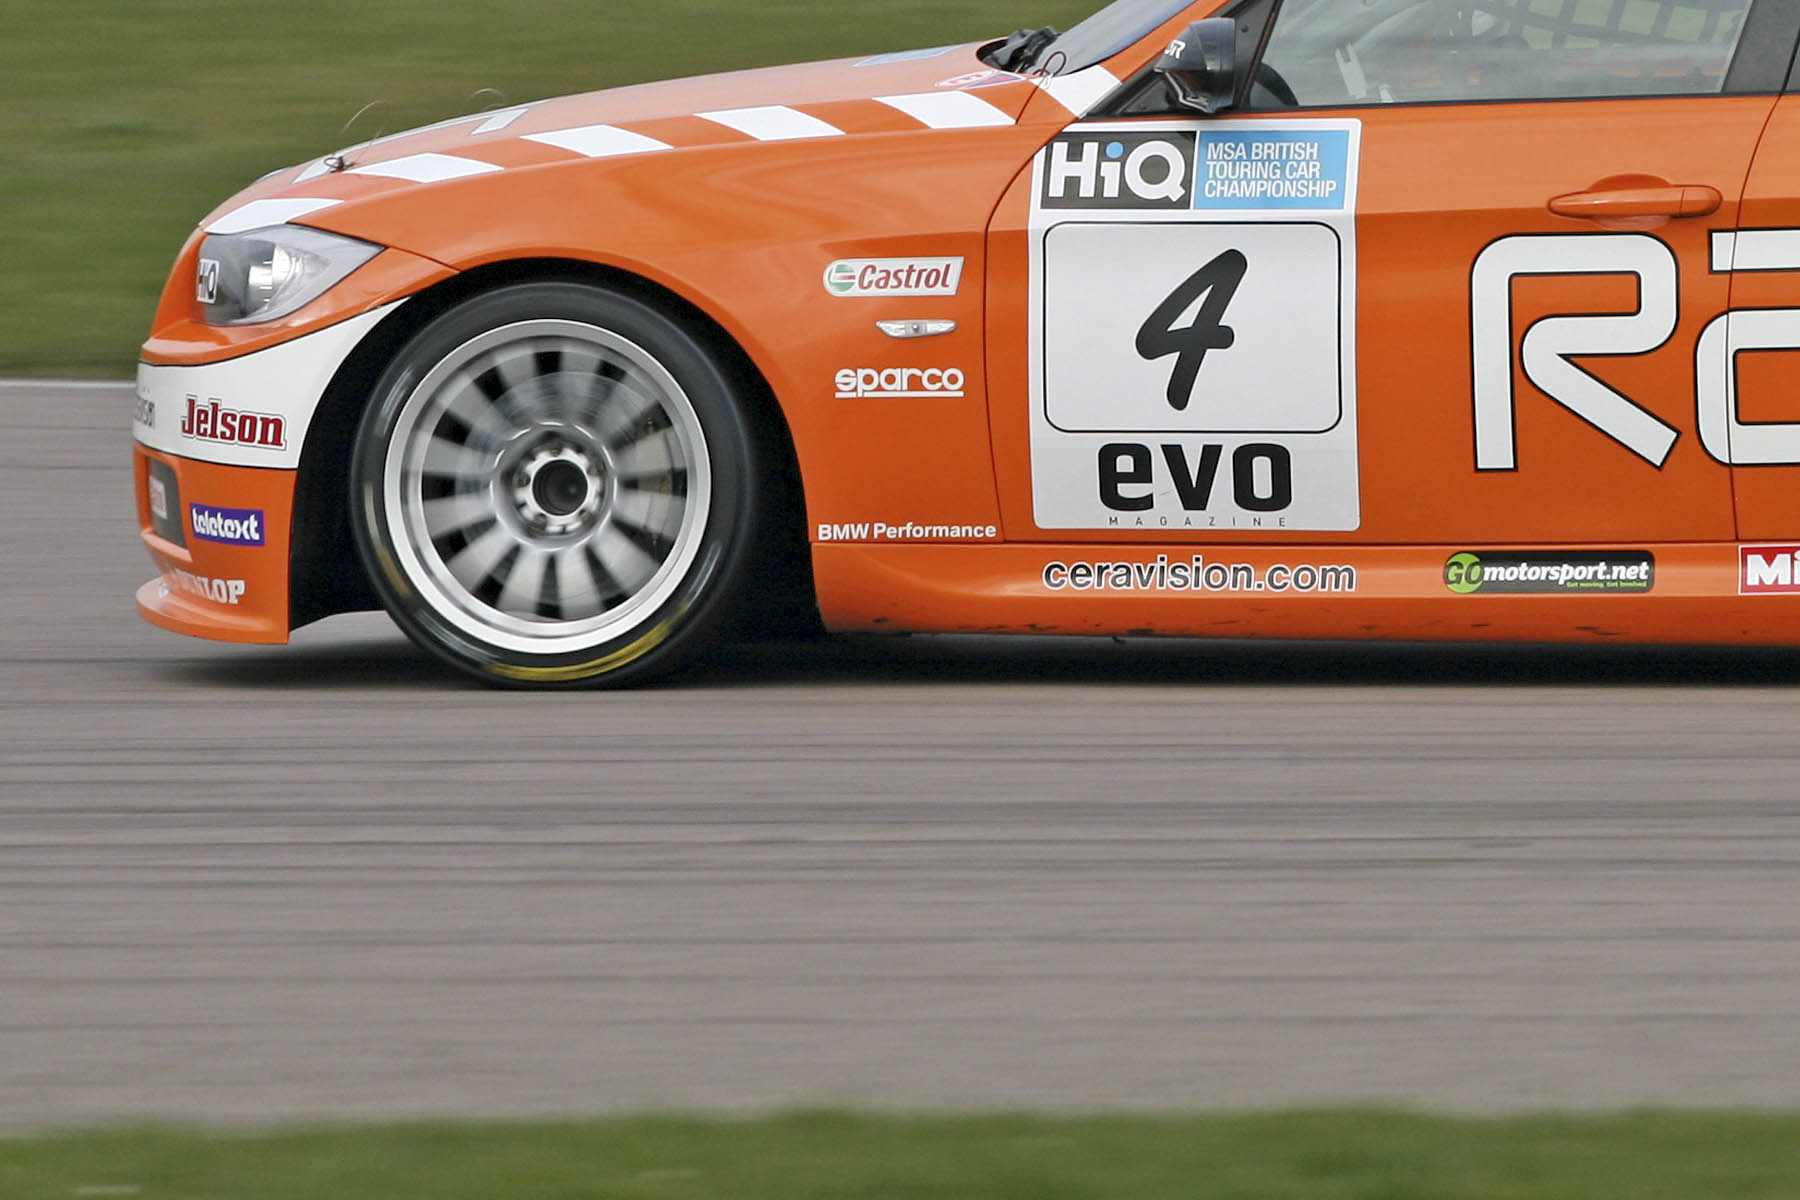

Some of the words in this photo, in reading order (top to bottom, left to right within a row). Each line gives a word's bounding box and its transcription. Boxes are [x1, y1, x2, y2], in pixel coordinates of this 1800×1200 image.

[1207, 142, 1246, 160] MSA
[1251, 142, 1318, 160] BRITISH
[1048, 139, 1186, 202] HiQ
[1206, 161, 1281, 179] TOURING
[1285, 161, 1320, 179] CAR
[1204, 180, 1337, 198] CHAMPIONSHIP
[857, 263, 952, 290] Castrol
[1135, 248, 1248, 411] 4
[834, 367, 965, 397] sparco
[181, 397, 284, 447] Jelson
[1098, 442, 1293, 512] evo
[192, 507, 260, 540] teletext
[817, 523, 870, 540] BMW
[873, 521, 997, 539] Performance
[1108, 516, 1287, 528] MAGAZINE
[1042, 555, 1356, 593] ceravision.com
